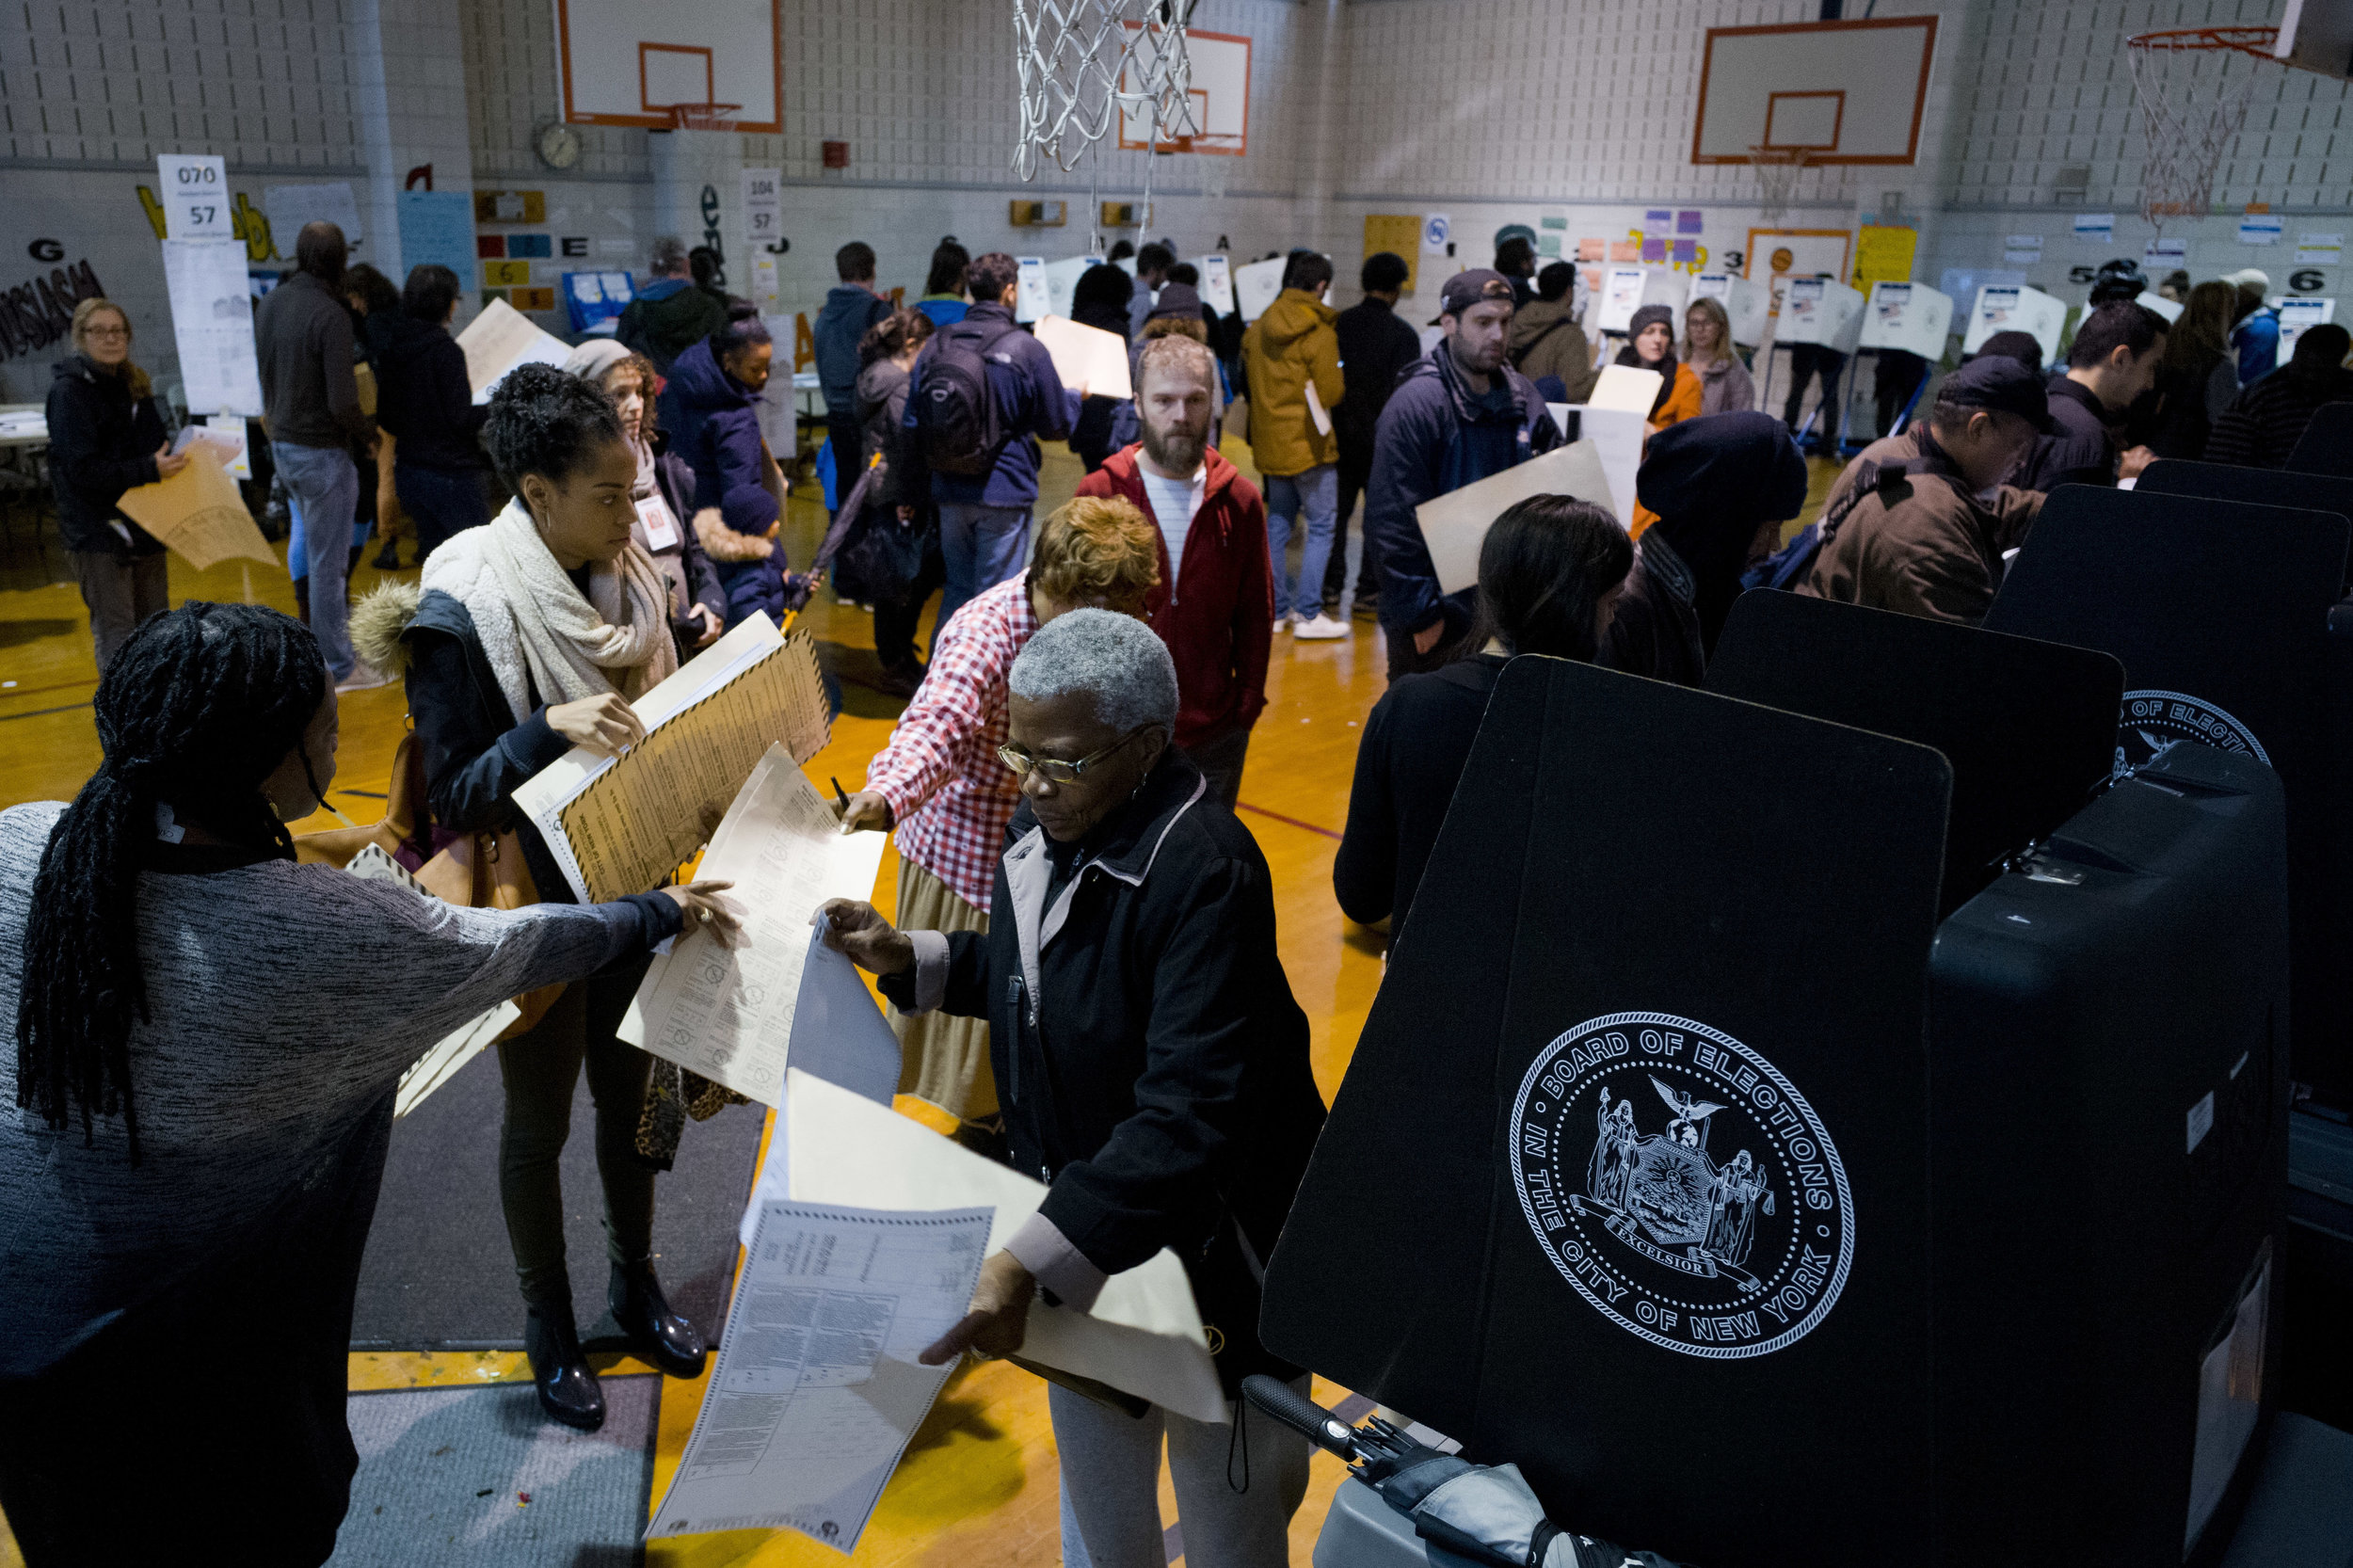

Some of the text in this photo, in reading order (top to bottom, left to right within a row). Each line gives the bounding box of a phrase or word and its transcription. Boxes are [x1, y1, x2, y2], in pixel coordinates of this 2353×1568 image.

[178, 167, 216, 184] 070
[190, 205, 216, 225] 57
[753, 213, 770, 229] 57
[28, 237, 65, 263] G
[562, 237, 588, 257] E
[1723, 250, 1743, 268] 3
[500, 264, 513, 282] 6
[2288, 268, 2326, 292] 6
[2132, 700, 2164, 717] OF
[578, 812, 590, 832] YORK
[585, 833, 596, 849] NEW
[1542, 1029, 1833, 1211] BOARD OF ELECTIONS
[1525, 1122, 1833, 1342] IN THE CITY OF NEW YORK
[1617, 1226, 1705, 1275] EXCELSIOR
